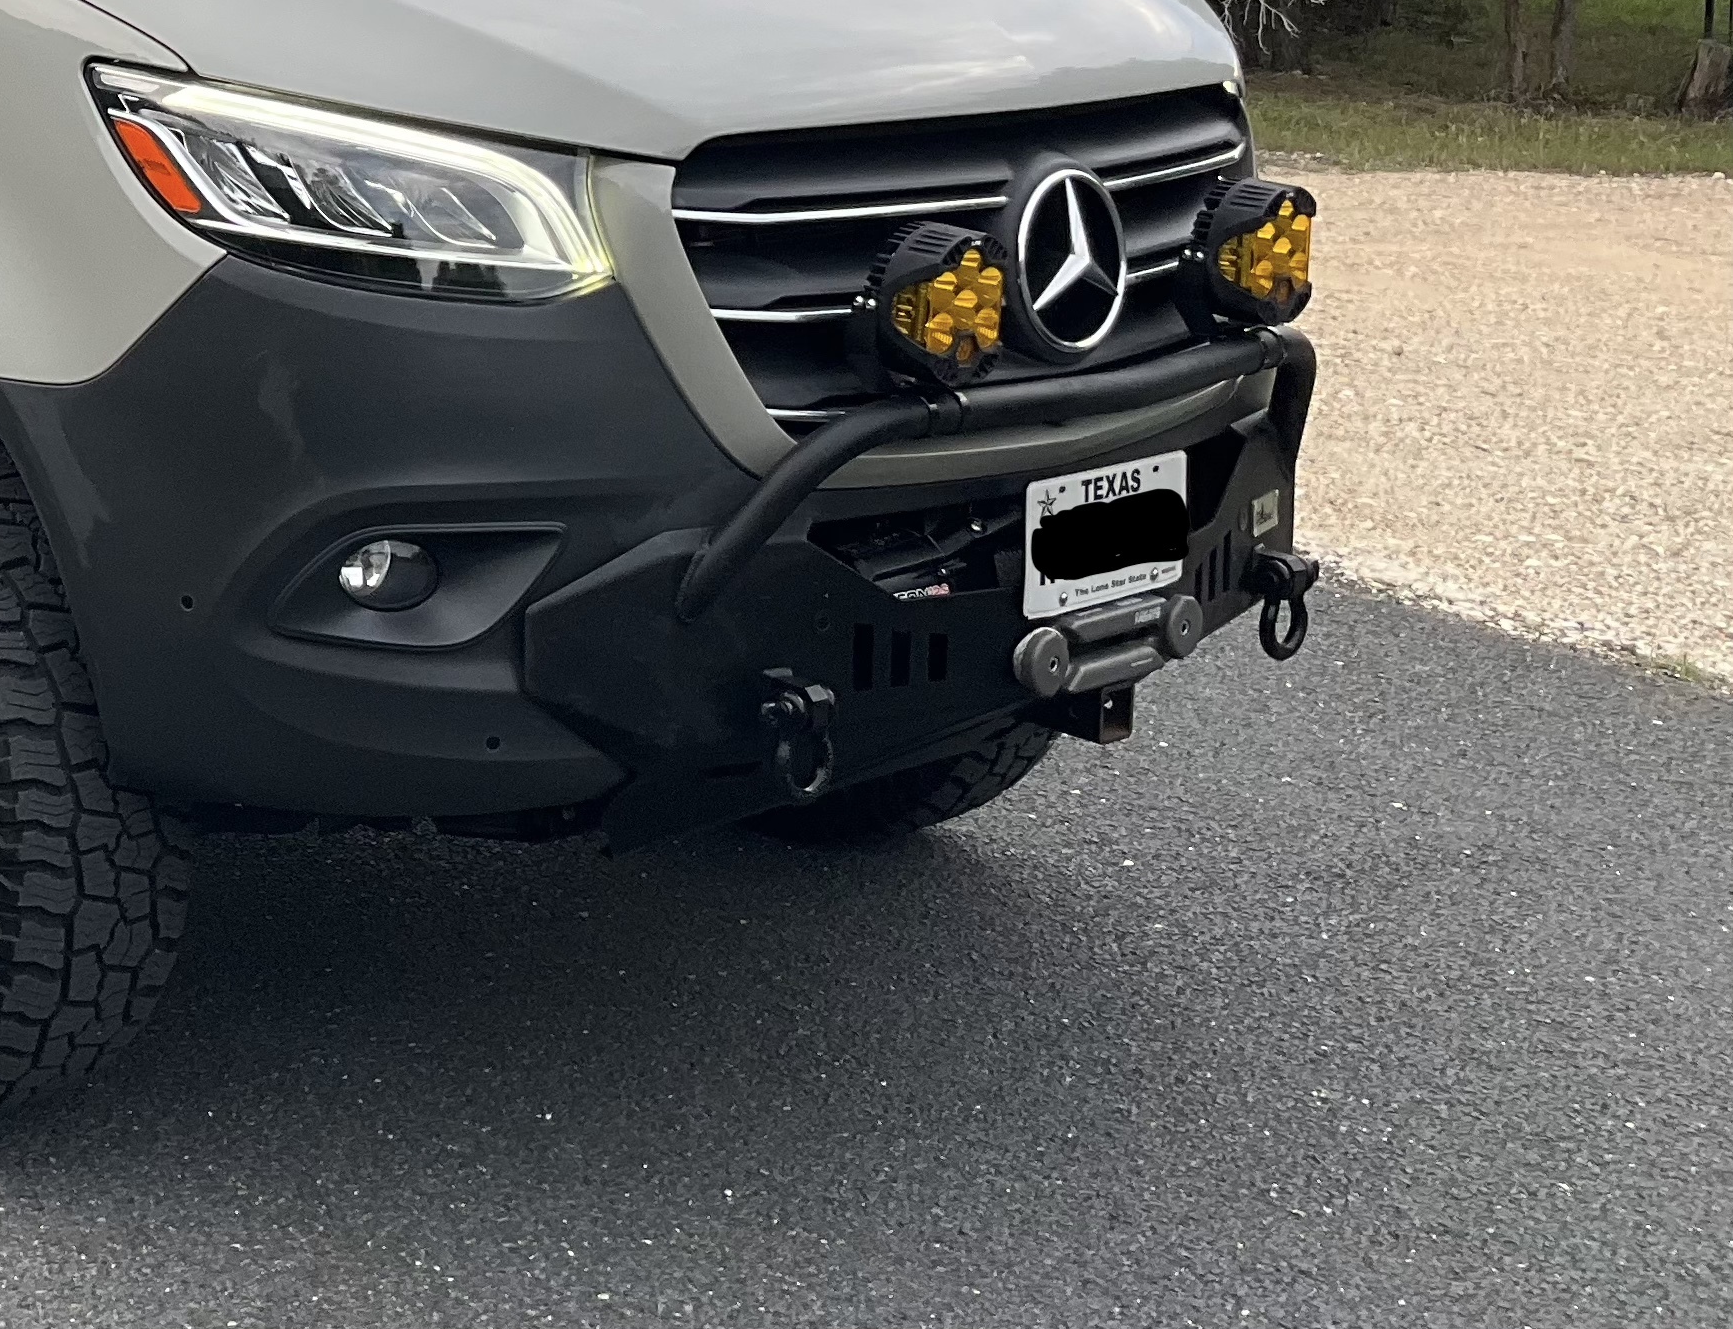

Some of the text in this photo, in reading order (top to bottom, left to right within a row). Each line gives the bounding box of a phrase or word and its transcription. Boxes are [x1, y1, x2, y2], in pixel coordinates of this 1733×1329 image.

[1081, 468, 1142, 502] TEXAS
[1074, 573, 1147, 597] The Lone Star State
